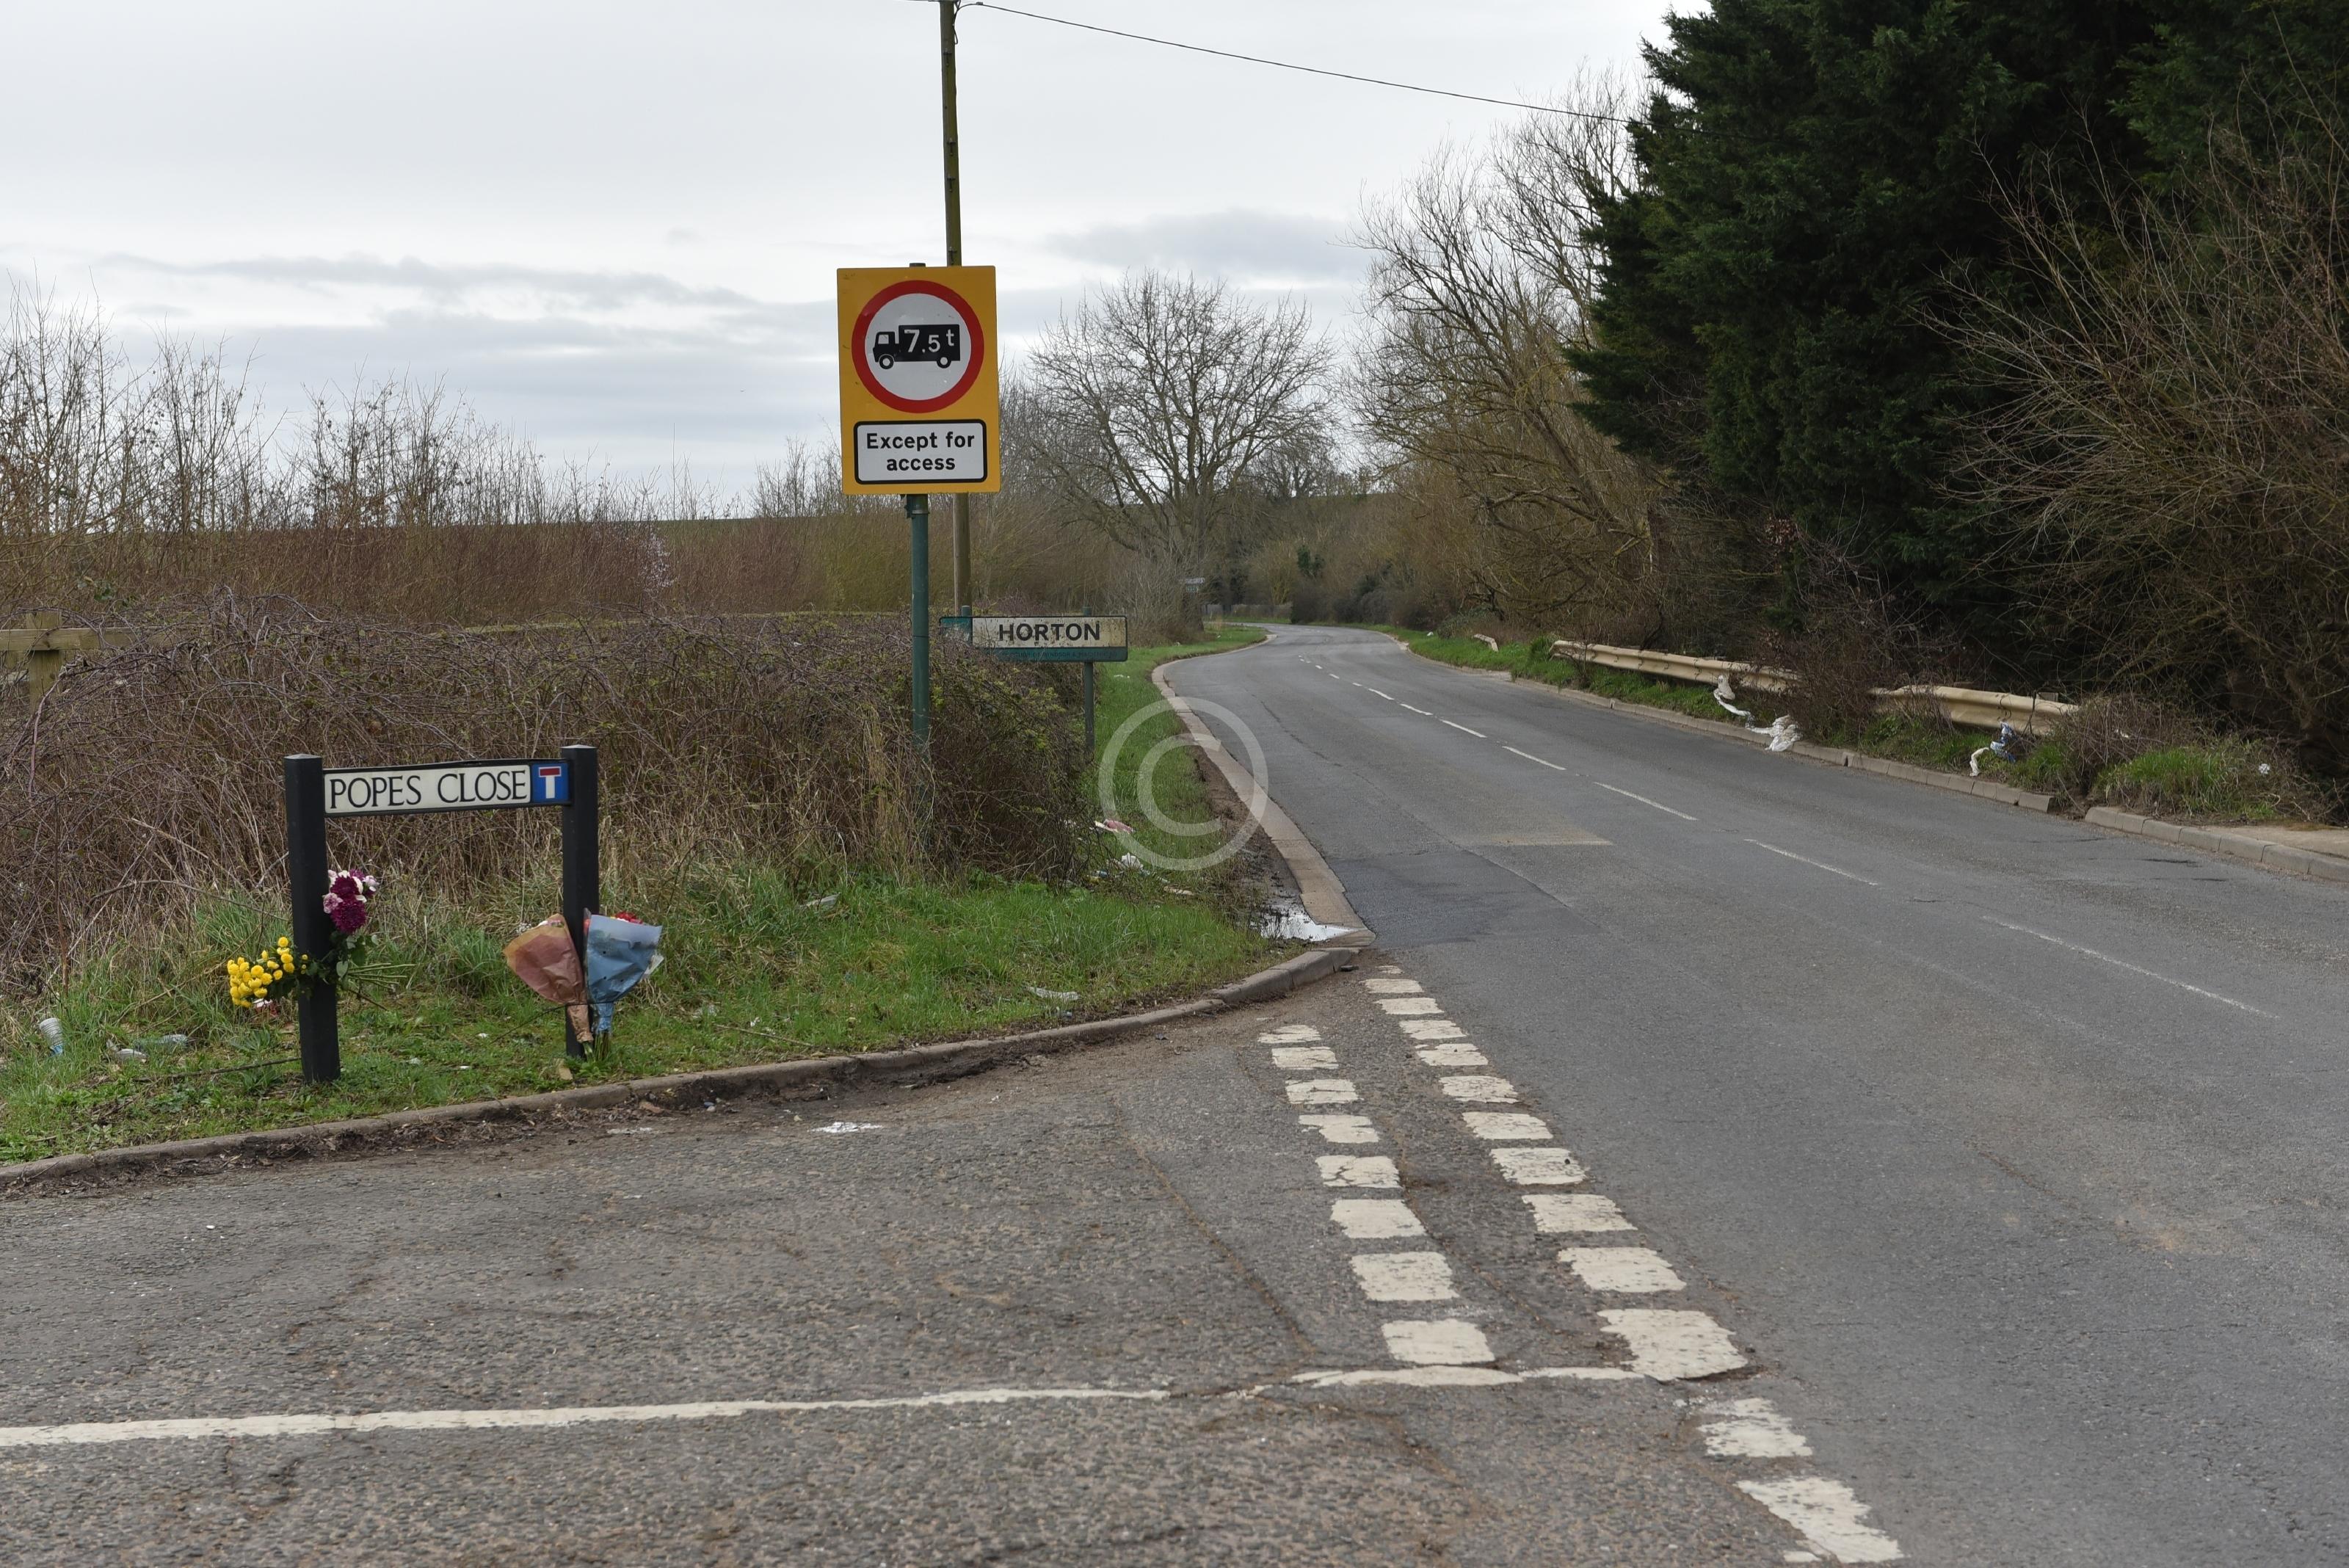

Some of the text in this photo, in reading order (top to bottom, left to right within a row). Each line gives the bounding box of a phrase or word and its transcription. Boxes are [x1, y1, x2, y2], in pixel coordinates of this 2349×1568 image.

[867, 431, 975, 451] Except for
[886, 457, 956, 471] access
[999, 623, 1100, 641] HORTON
[330, 770, 528, 810] POPES CLOSE
